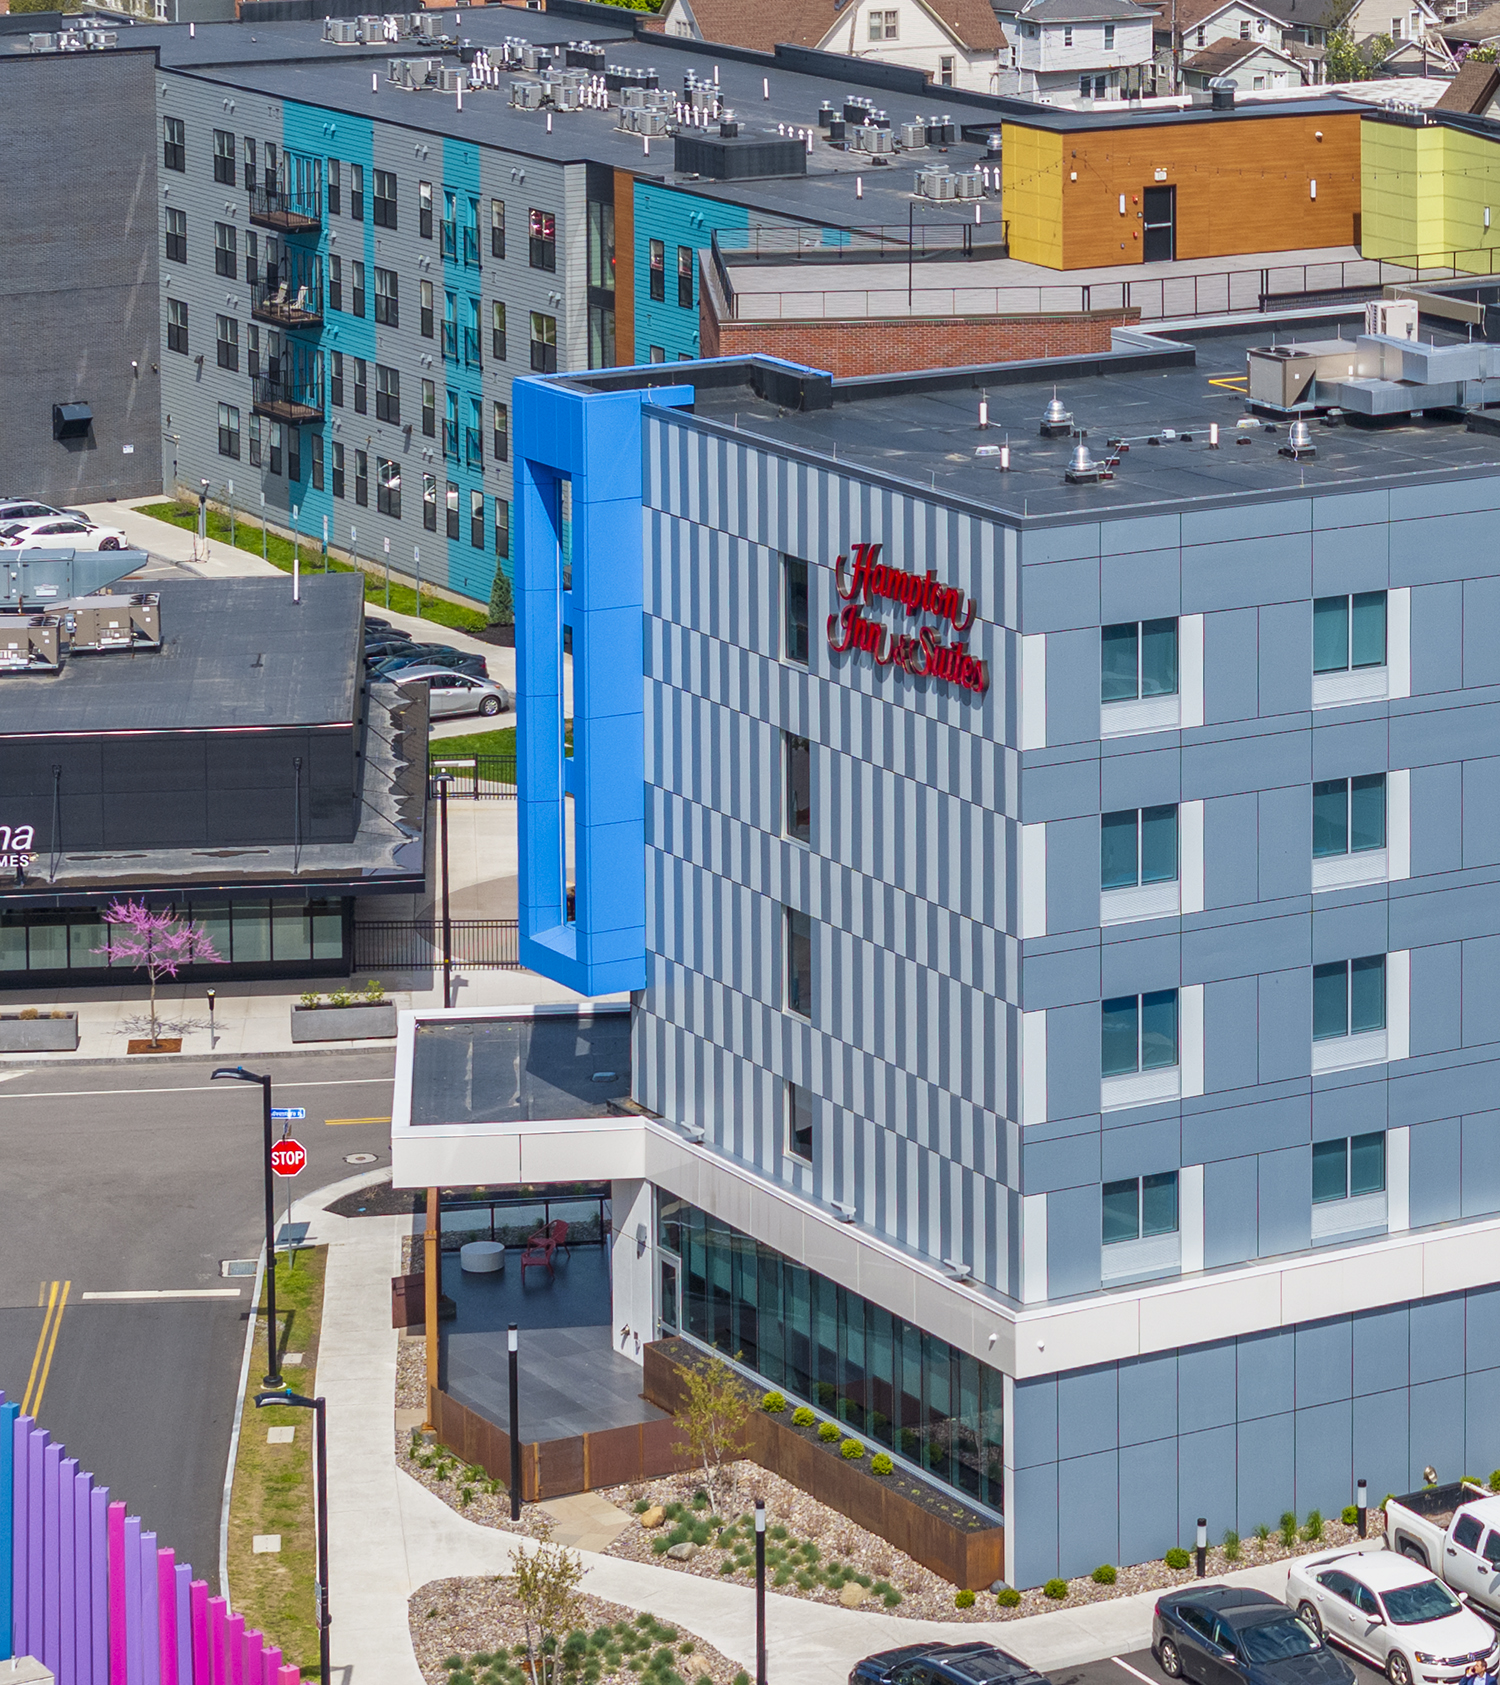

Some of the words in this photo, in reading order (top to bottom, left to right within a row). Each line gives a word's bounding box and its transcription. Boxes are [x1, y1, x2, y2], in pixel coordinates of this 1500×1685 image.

[835, 543, 976, 631] Hampton
[827, 604, 900, 666] Inn
[909, 626, 989, 692] Suites
[272, 1151, 304, 1165] STOP
